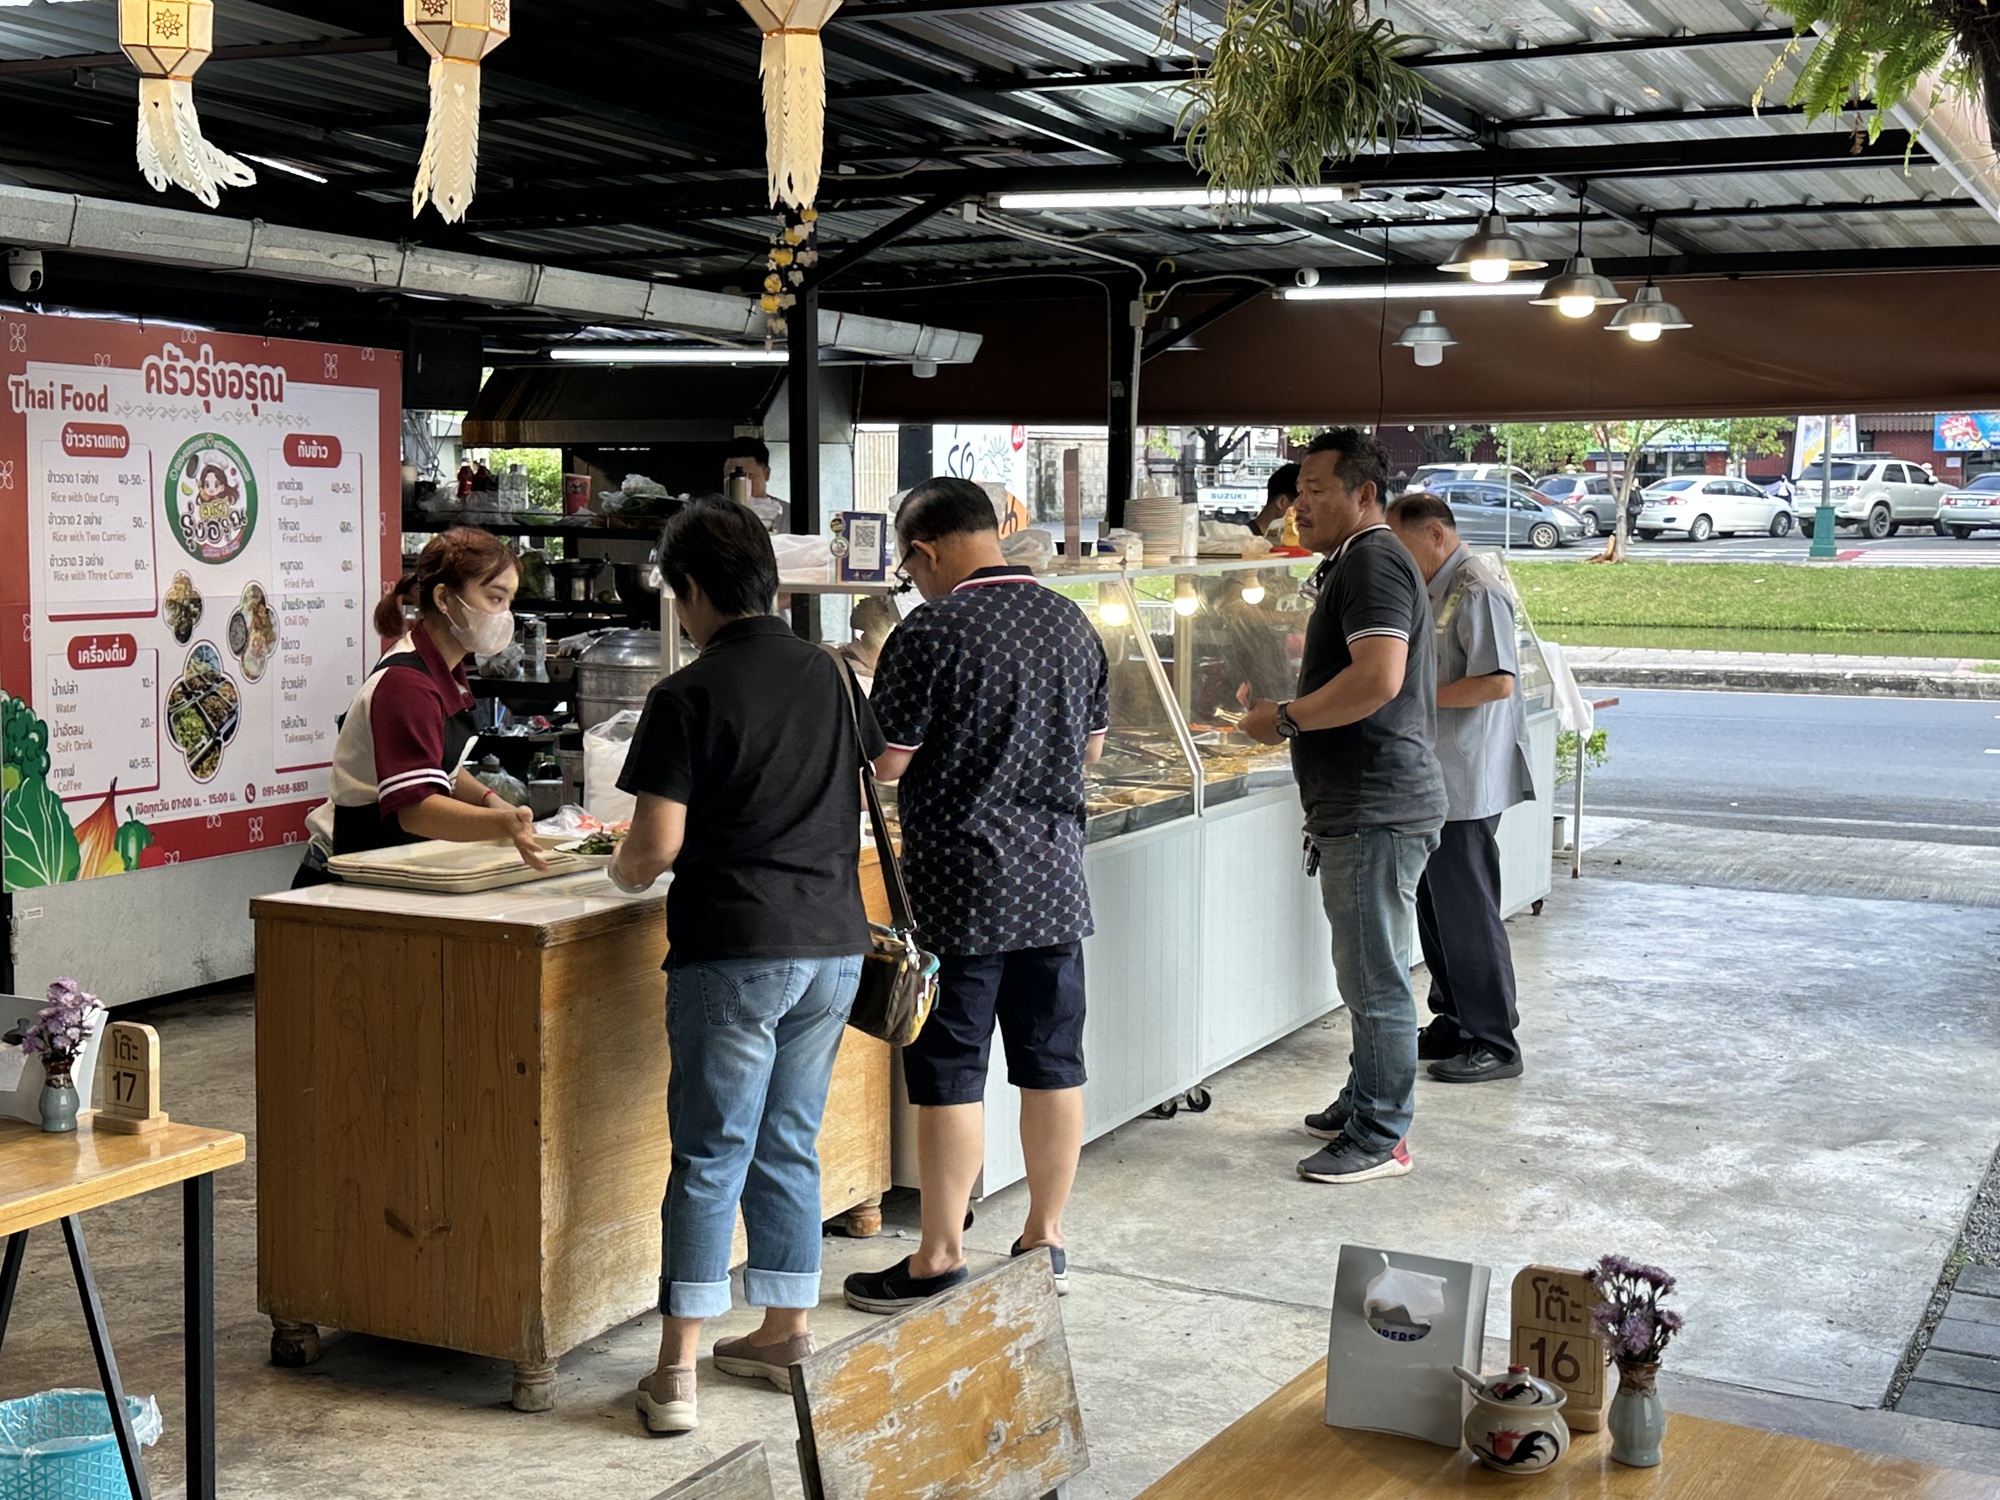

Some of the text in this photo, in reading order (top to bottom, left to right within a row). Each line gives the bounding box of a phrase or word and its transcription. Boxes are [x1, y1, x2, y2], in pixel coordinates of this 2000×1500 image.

[144, 349, 284, 416] ครัวรุ่งอรุณ
[10, 380, 108, 412] Thai Food
[65, 427, 126, 450] ข้าวราดแกง
[297, 439, 328, 459] กับข้าว
[47, 469, 74, 484] ข้าวราด
[51, 491, 119, 506] Rice with One Curry
[281, 495, 314, 508] Curry Bowl
[48, 512, 75, 526] ข้าวราด
[77, 514, 82, 525] 2
[52, 531, 126, 542] Rice with Two Curries
[282, 533, 322, 543] Fried Chicken
[50, 554, 76, 567] ข้าวราด
[78, 556, 84, 566] 3
[53, 569, 134, 582] Rice with Three Curries
[284, 579, 300, 589] Fried
[284, 615, 309, 628] Chili Dip
[78, 636, 126, 664] เครื่องดื่ม
[284, 654, 313, 667] Fried Egg
[52, 678, 79, 697] น้ำเปล่า
[284, 691, 297, 702] Rice
[56, 703, 77, 714] Water
[53, 720, 84, 738] น้ำอัดลม
[314, 730, 325, 741] Set
[57, 739, 93, 754] Soft Drink
[53, 763, 75, 779] กาแฟ
[57, 780, 82, 793] Coffee
[112, 1028, 139, 1061] โต๊ะ
[112, 1071, 137, 1103] 17
[1531, 1276, 1583, 1323] โต๊ะ
[1530, 1336, 1581, 1384] 16
